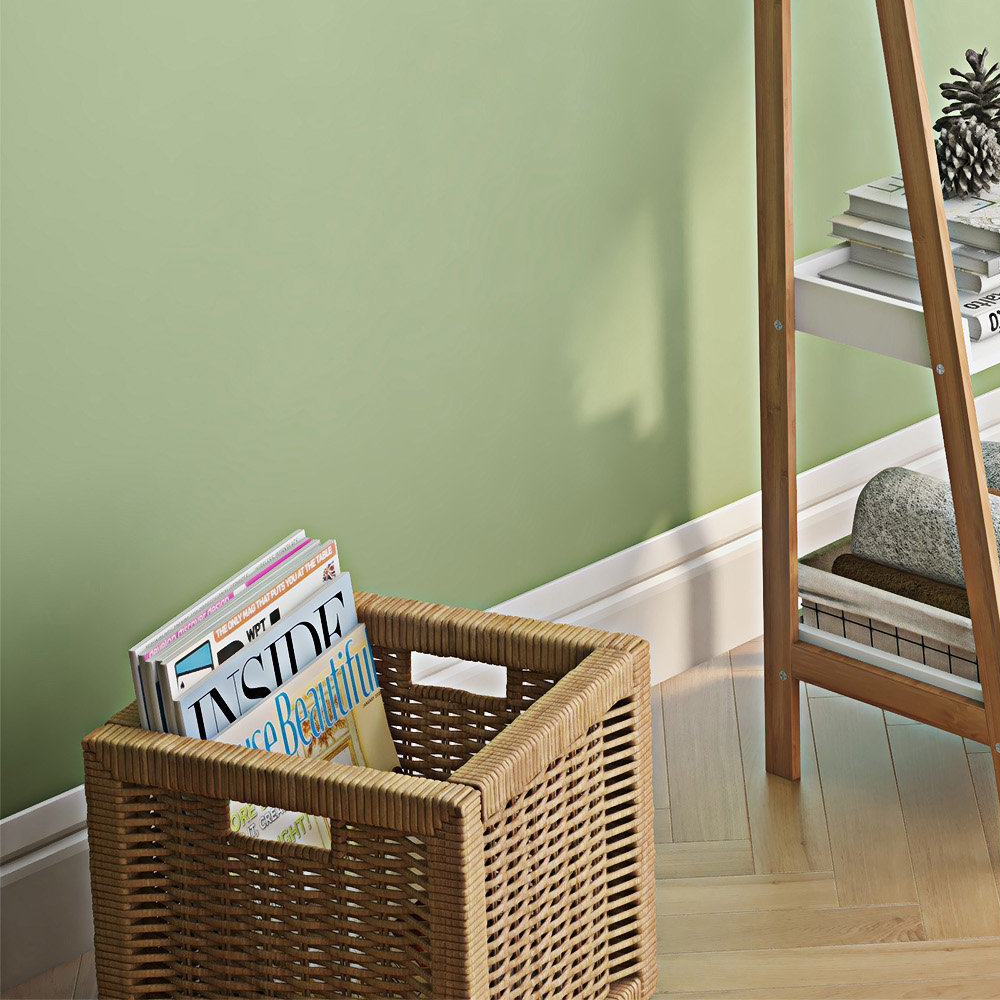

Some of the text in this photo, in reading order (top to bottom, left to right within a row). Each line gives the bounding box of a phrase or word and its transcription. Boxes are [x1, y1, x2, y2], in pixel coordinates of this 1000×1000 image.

[215, 627, 228, 639] THE
[227, 616, 242, 631] ONLY
[243, 605, 256, 620] MAG
[256, 595, 270, 610] THAT
[270, 584, 285, 599] PUTS
[285, 574, 297, 588] YOU
[297, 567, 304, 578] AT
[304, 559, 316, 574] THE
[316, 545, 333, 565] TABLE
[246, 617, 266, 642] WPT
[188, 590, 345, 741] INSIDE
[273, 639, 379, 757] Beautiful
